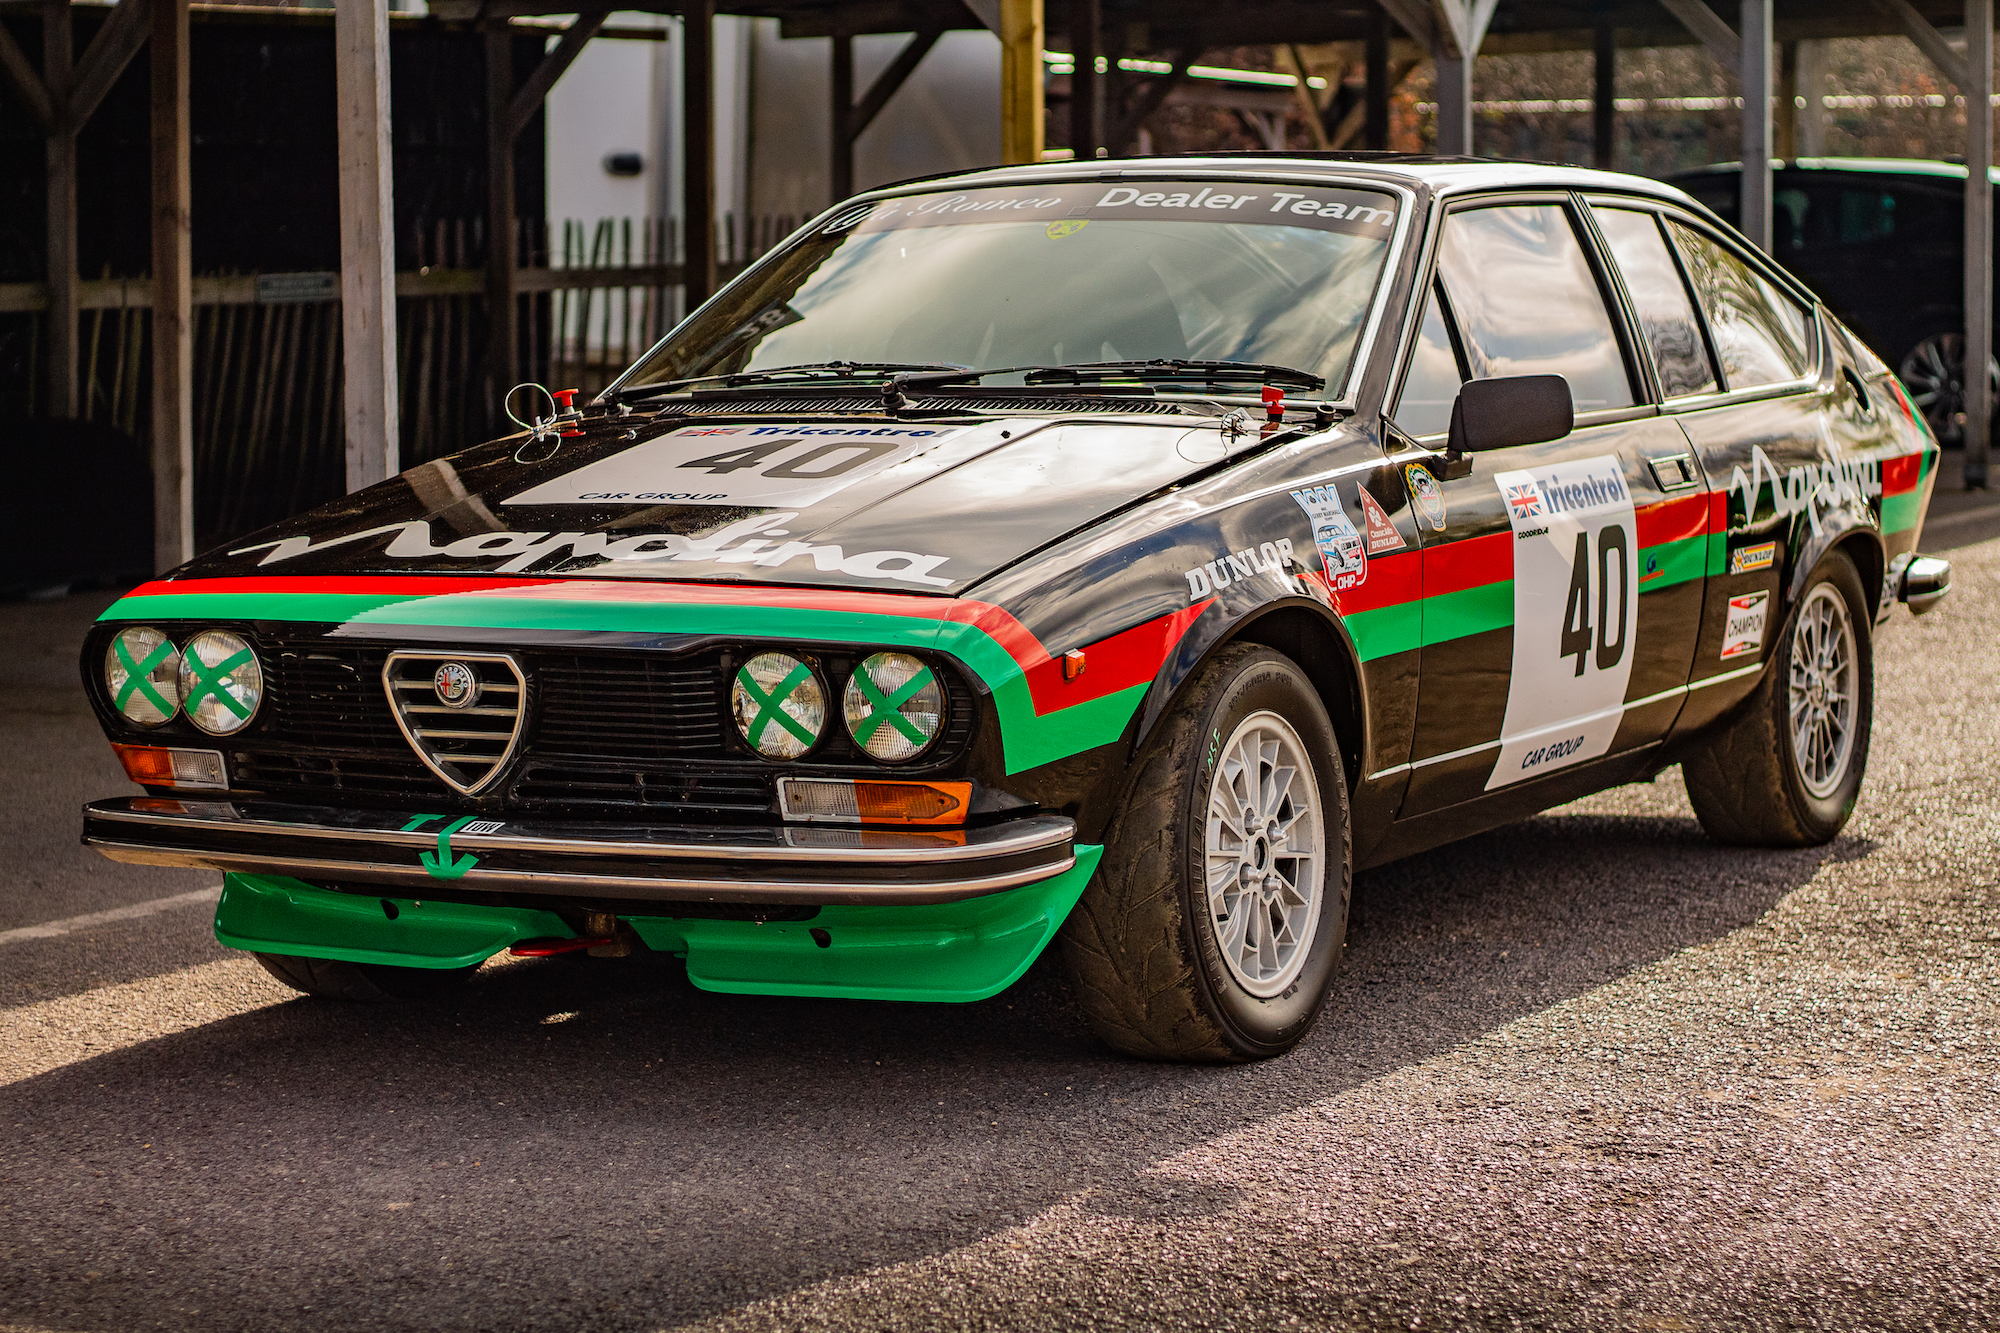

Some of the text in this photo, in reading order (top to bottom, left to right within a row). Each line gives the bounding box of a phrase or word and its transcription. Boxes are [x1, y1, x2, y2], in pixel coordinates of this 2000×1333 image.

[906, 195, 1062, 216] Romeo
[1095, 187, 1263, 211] Dealer
[1269, 192, 1396, 228] Team
[748, 426, 957, 438] Tricentrol
[675, 439, 900, 479] 40
[1537, 468, 1627, 514] Tricentrol
[228, 512, 954, 588] Napolina
[1371, 536, 1399, 549] DUNLOP
[1184, 537, 1294, 601] DUNLOP
[1337, 574, 1356, 590] OHP
[1560, 524, 1627, 678] 40
[1728, 613, 1765, 638] CHAMPION
[1206, 727, 1221, 773] NSF
[1521, 735, 1584, 769] CAR GROUP
